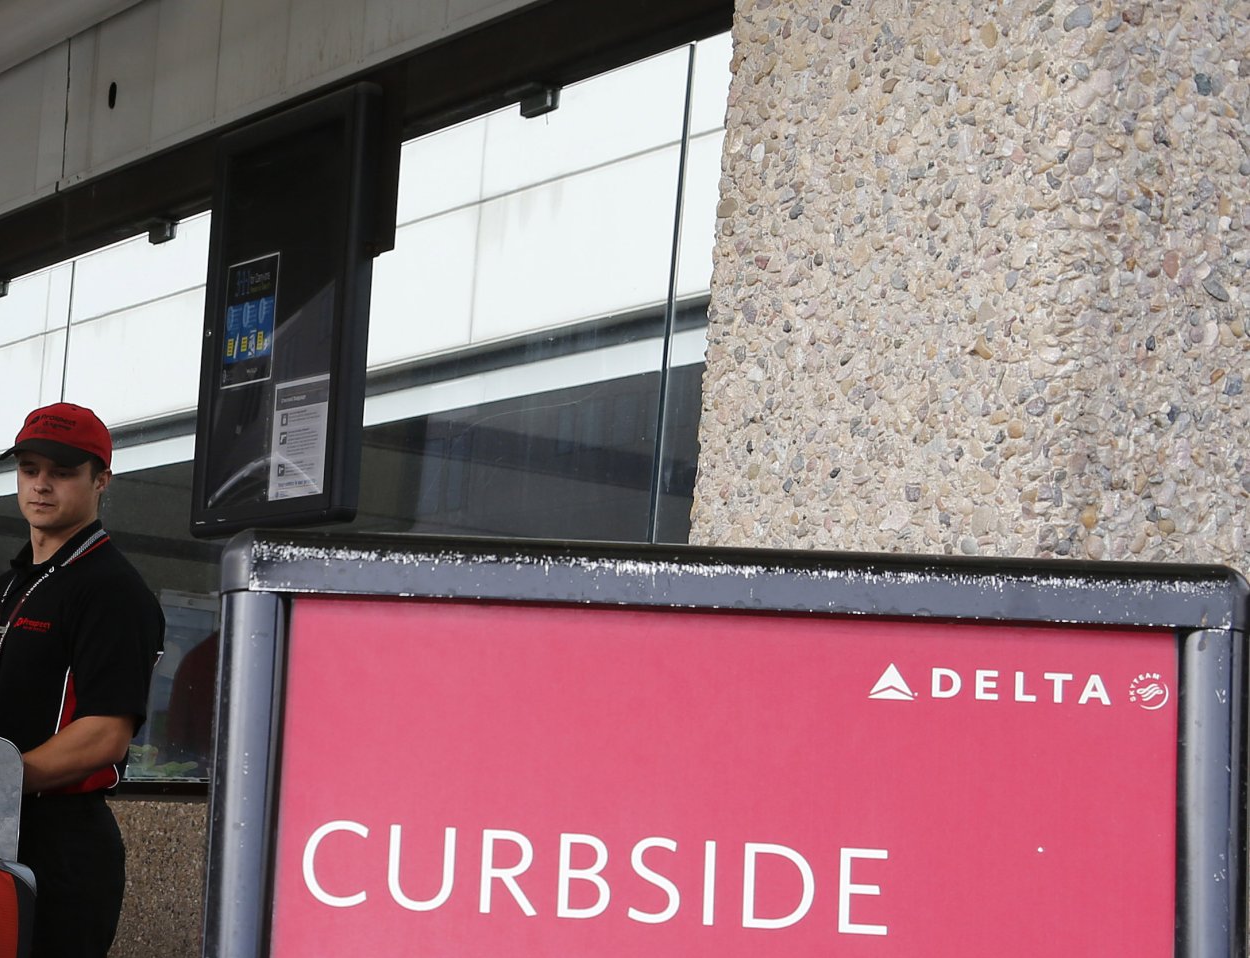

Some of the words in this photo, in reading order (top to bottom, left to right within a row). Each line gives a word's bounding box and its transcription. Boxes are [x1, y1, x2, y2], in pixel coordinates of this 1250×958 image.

[931, 667, 1112, 705] DELTA
[1128, 672, 1161, 702] SKYTEAM
[302, 819, 889, 936] CURBSIDE
